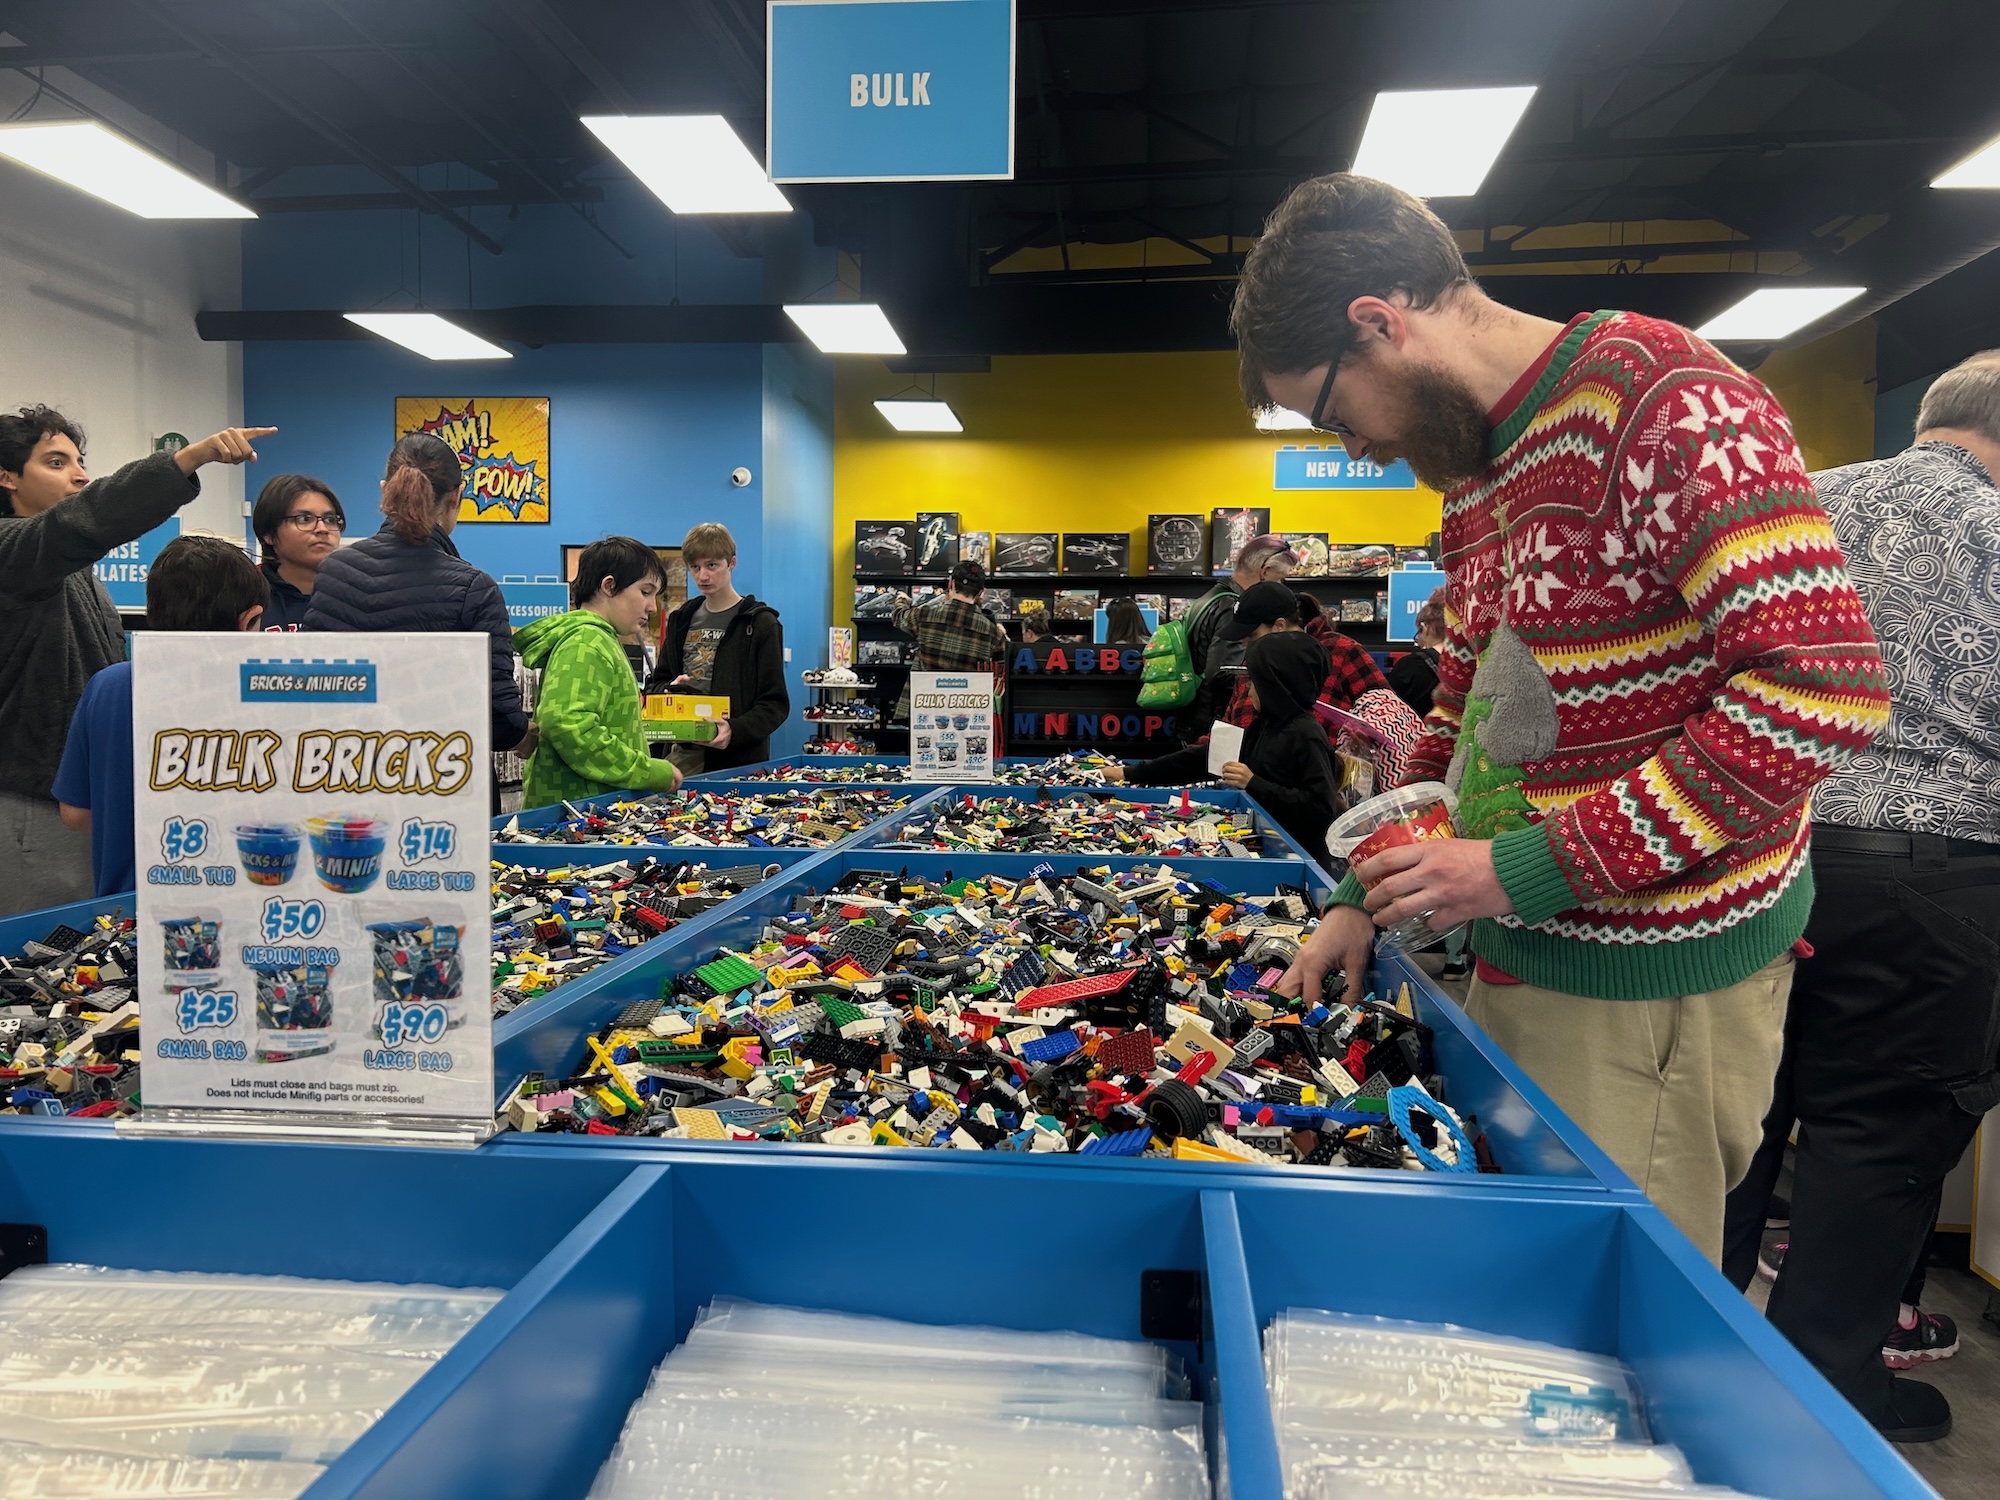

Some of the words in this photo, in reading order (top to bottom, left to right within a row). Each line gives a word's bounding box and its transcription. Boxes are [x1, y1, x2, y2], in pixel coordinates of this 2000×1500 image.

[850, 72, 931, 107] BULK
[431, 410, 489, 453] AM!
[1306, 461, 1341, 478] NEW
[1346, 461, 1384, 478] SETS
[472, 466, 534, 500] POW!
[104, 541, 139, 559] ASE
[249, 674, 293, 691] BRICKS
[294, 678, 303, 690] &
[305, 675, 367, 691] MINIFIGS
[914, 693, 945, 708] BULK
[948, 694, 990, 709] BRICKS
[151, 728, 281, 792] BULK
[293, 730, 473, 796] BRICKS
[162, 817, 206, 863] $8
[401, 818, 455, 864] $14
[148, 865, 201, 885] SMALL
[203, 866, 235, 886] TUB
[387, 870, 440, 889] LARGE
[442, 872, 475, 891] TUB
[262, 897, 324, 943] $50
[242, 946, 302, 966] MEDIUM
[305, 948, 340, 966] BAG
[177, 987, 237, 1033] $25
[381, 1002, 447, 1048] $90
[158, 1039, 211, 1059] SMALL
[212, 1040, 247, 1060] BAG
[364, 1050, 416, 1070] LARGE
[418, 1051, 452, 1071] BAG
[206, 1088, 231, 1098] Does
[234, 1089, 249, 1098] not
[252, 1089, 287, 1099] include
[290, 1091, 322, 1102] Minifig
[324, 1092, 349, 1102] parts
[351, 1094, 362, 1102] or
[364, 1094, 425, 1105] accessories!
[231, 1078, 251, 1089] Lids
[254, 1080, 277, 1089] must
[280, 1080, 306, 1090] close
[308, 1081, 327, 1090] and
[329, 1081, 352, 1093] bags
[356, 1083, 380, 1092] must
[383, 1083, 399, 1094] zip.
